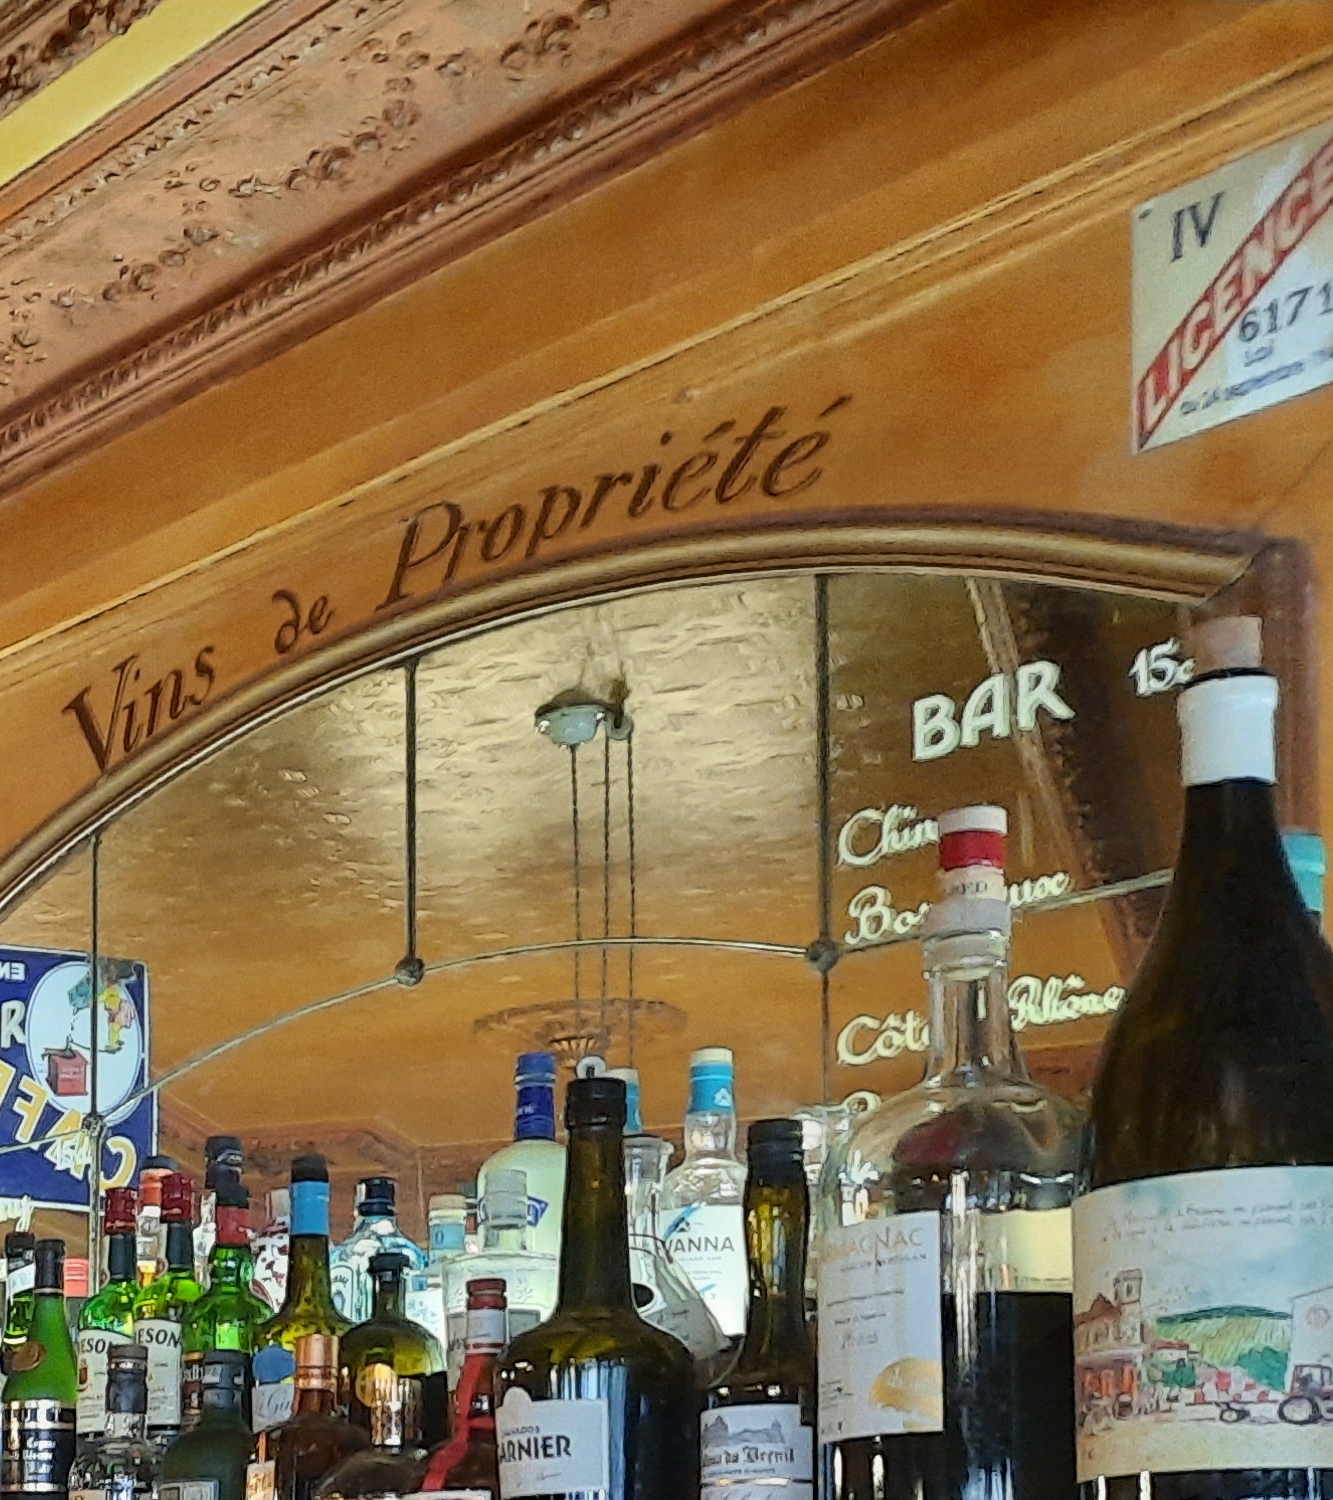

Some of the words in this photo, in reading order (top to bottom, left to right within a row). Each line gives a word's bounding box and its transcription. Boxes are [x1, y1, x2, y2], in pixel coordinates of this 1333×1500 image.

[1171, 192, 1224, 263] IV
[63, 645, 216, 774] Vins
[273, 590, 331, 655] de
[376, 395, 854, 612] Propriété
[913, 659, 1076, 761] BAR
